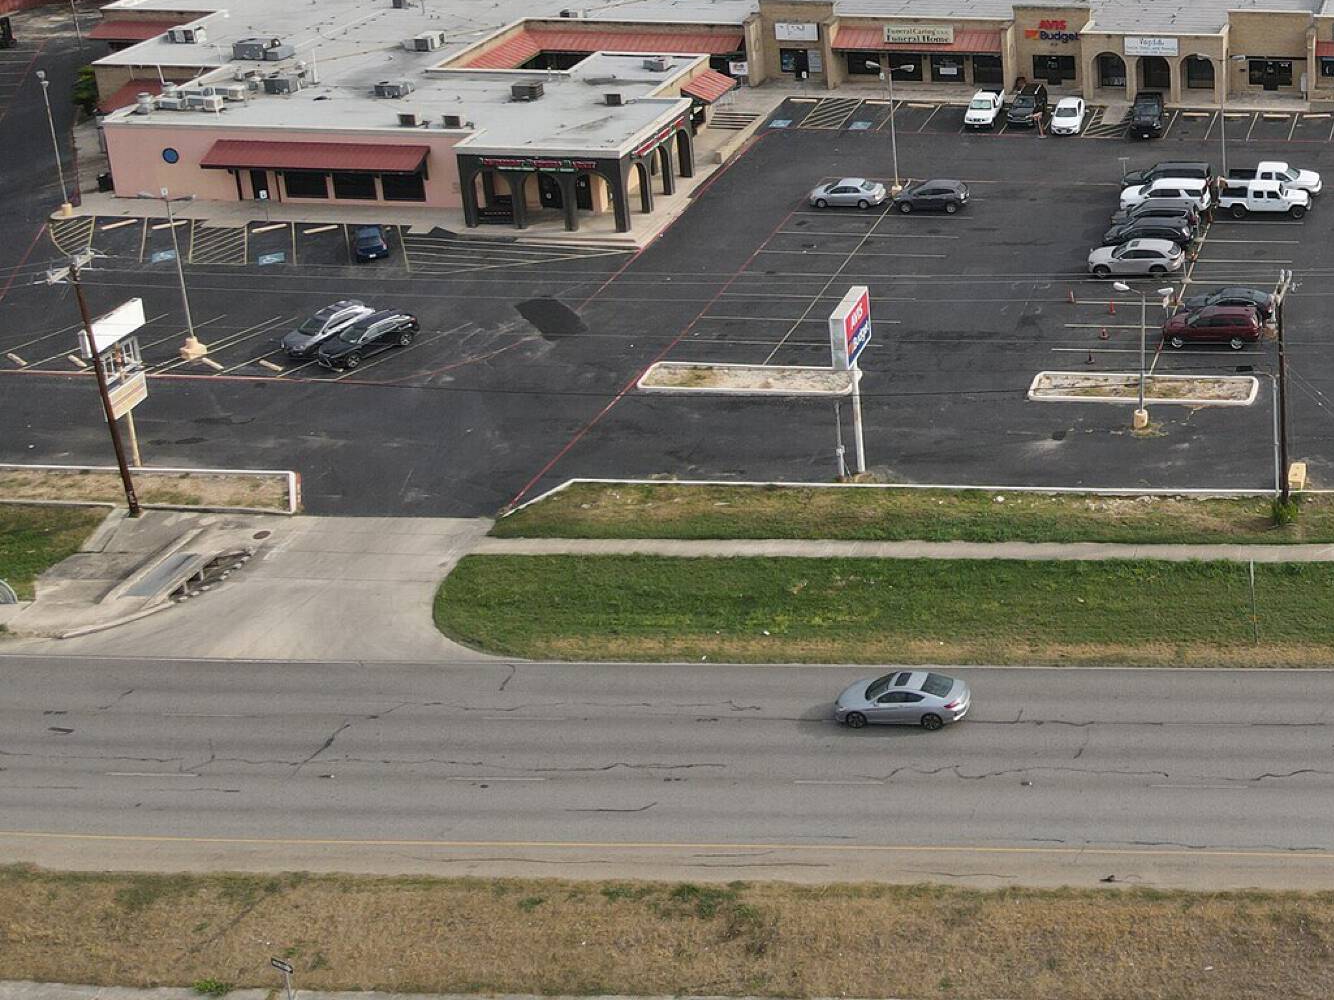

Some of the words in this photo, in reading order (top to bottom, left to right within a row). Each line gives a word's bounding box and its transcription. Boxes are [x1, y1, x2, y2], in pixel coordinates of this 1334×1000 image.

[886, 34, 920, 43] Funeral
[922, 35, 949, 43] Home
[1039, 30, 1081, 44] Budget
